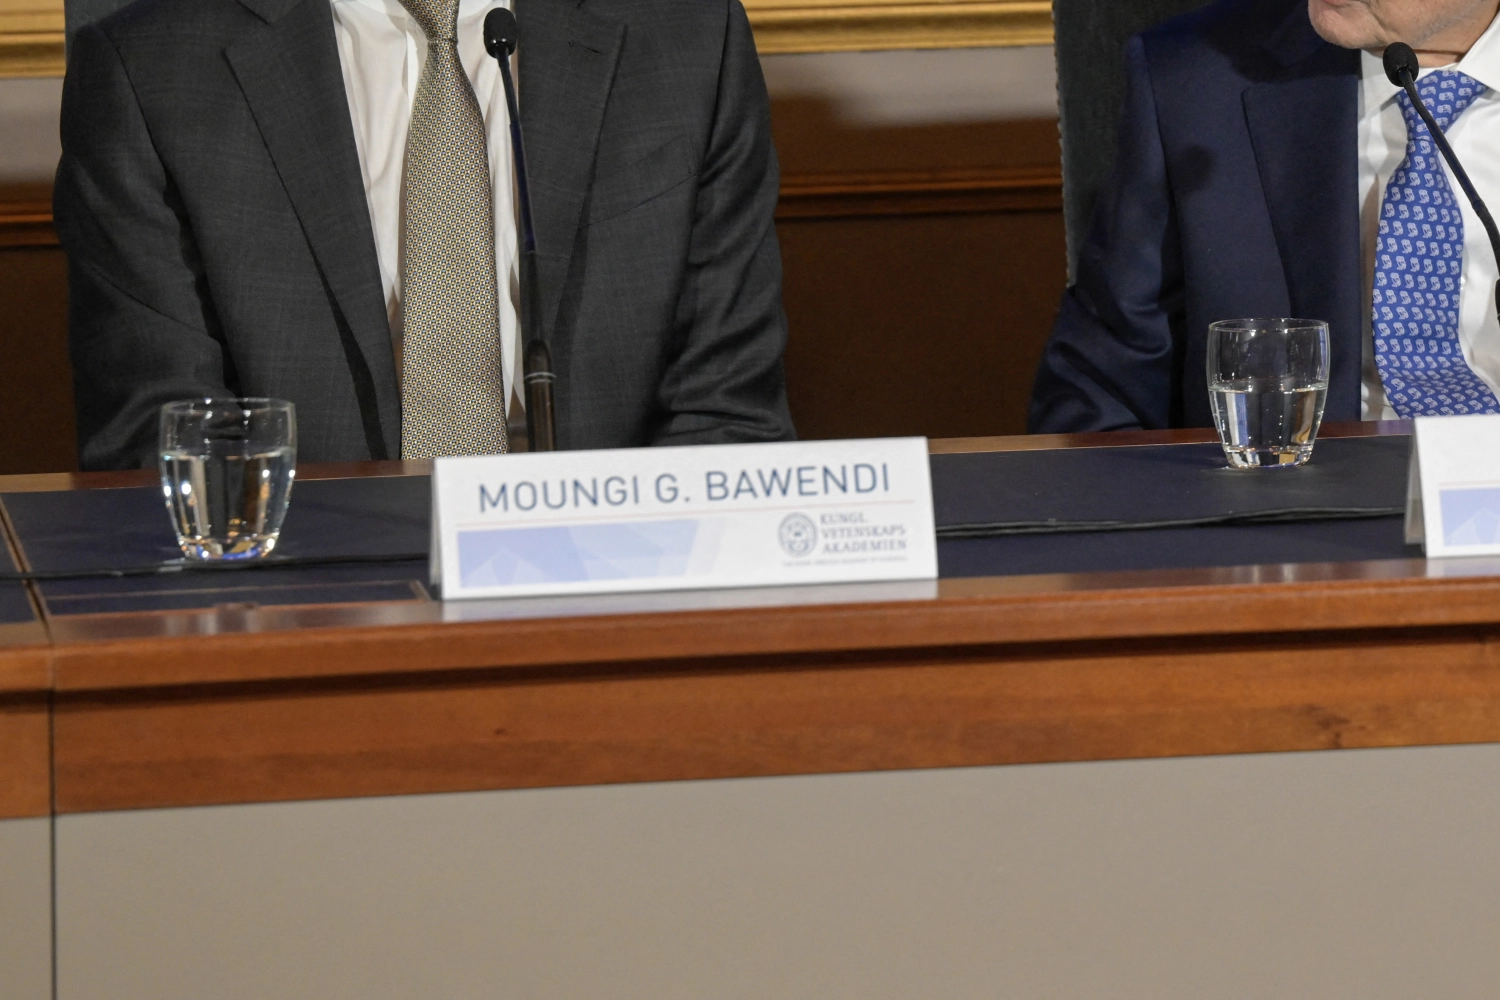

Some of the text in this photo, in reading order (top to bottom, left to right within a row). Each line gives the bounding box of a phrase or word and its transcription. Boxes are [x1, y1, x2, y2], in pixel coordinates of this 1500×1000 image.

[478, 463, 890, 513] MOUNGI G. BAWENDI
